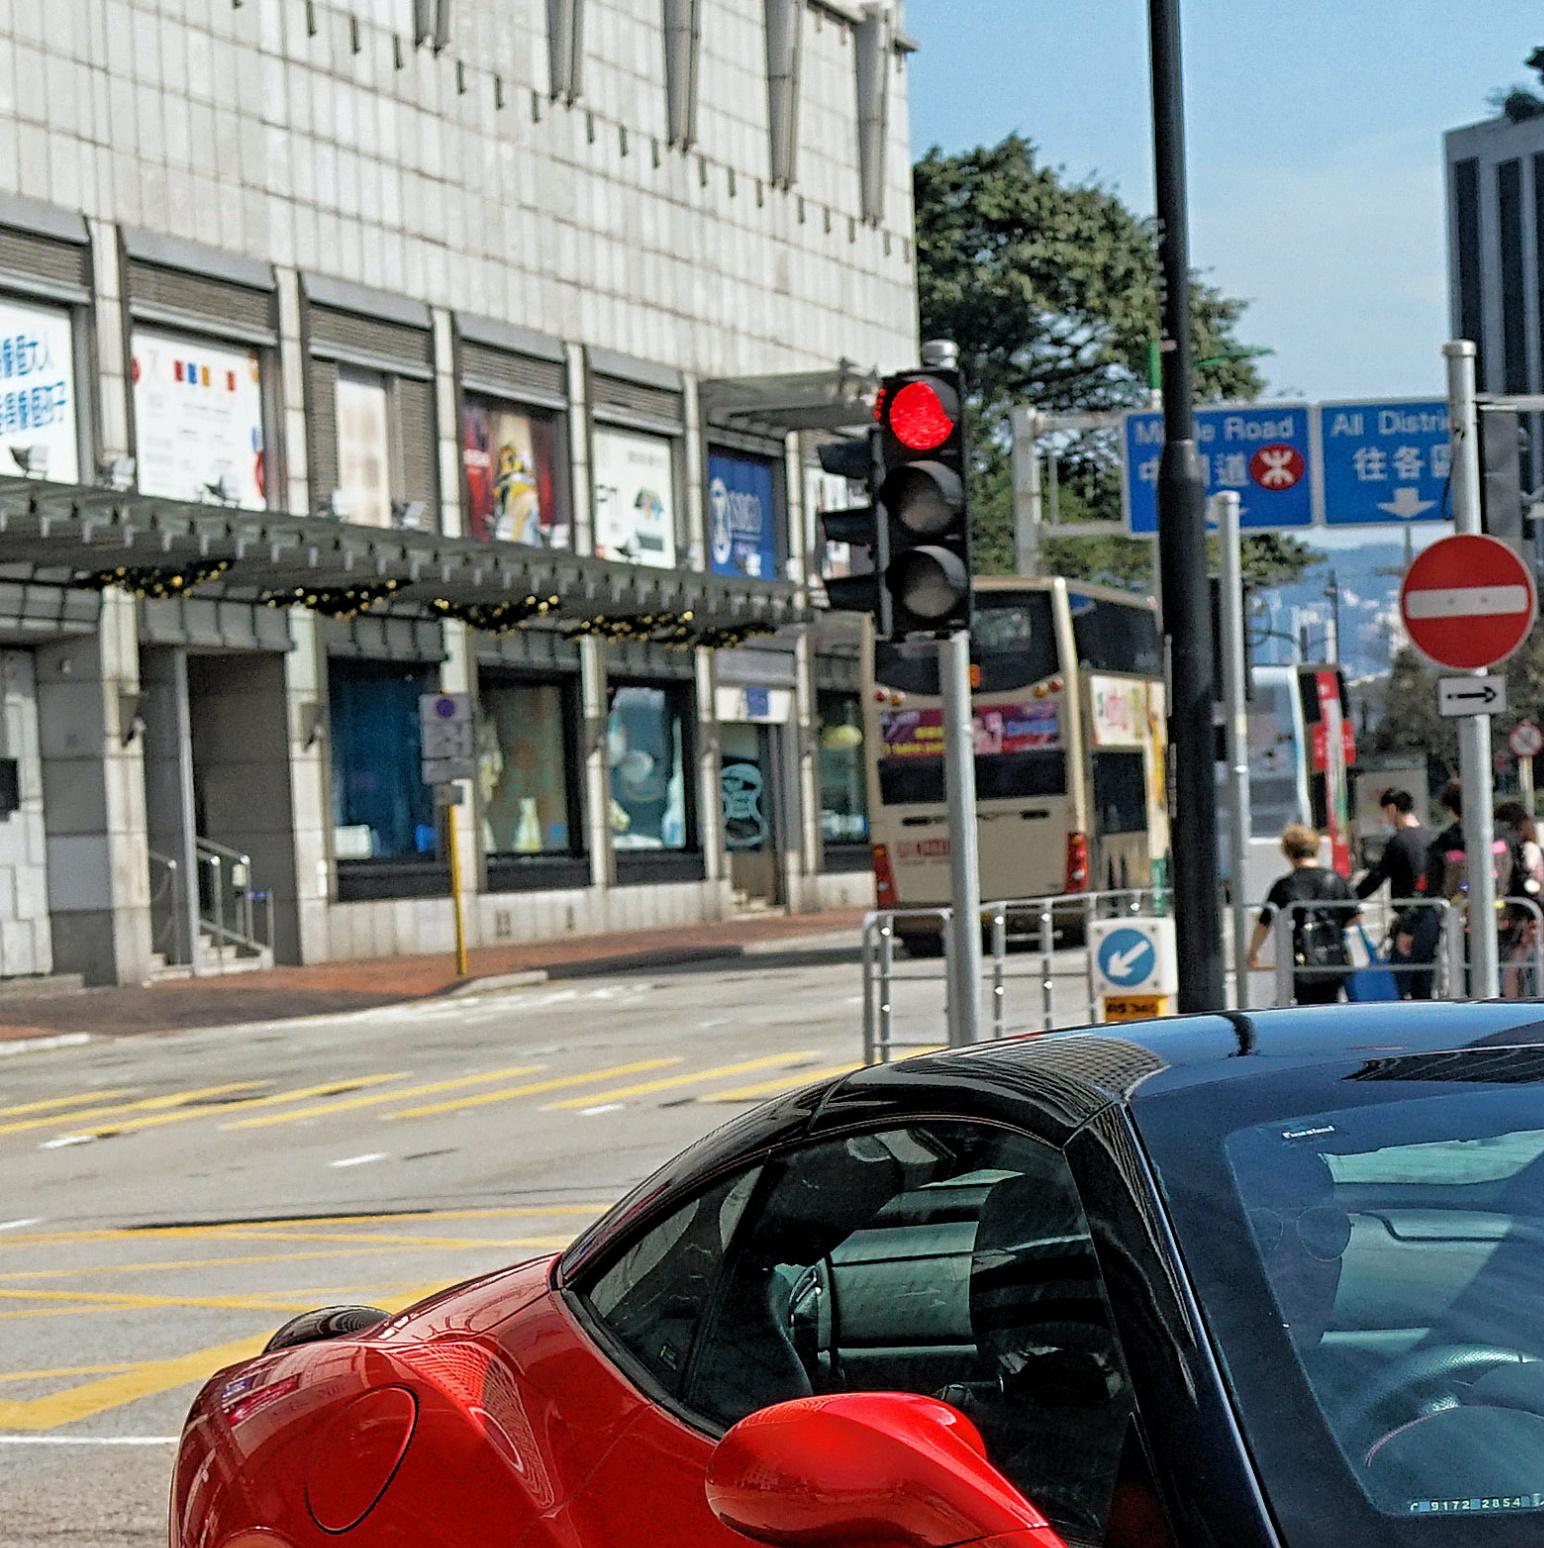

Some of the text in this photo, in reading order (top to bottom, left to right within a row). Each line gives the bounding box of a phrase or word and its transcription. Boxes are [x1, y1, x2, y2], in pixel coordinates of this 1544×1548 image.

[1134, 415, 1294, 446] Mle Road
[1330, 409, 1450, 437] All Distri
[1138, 448, 1250, 488] 中道
